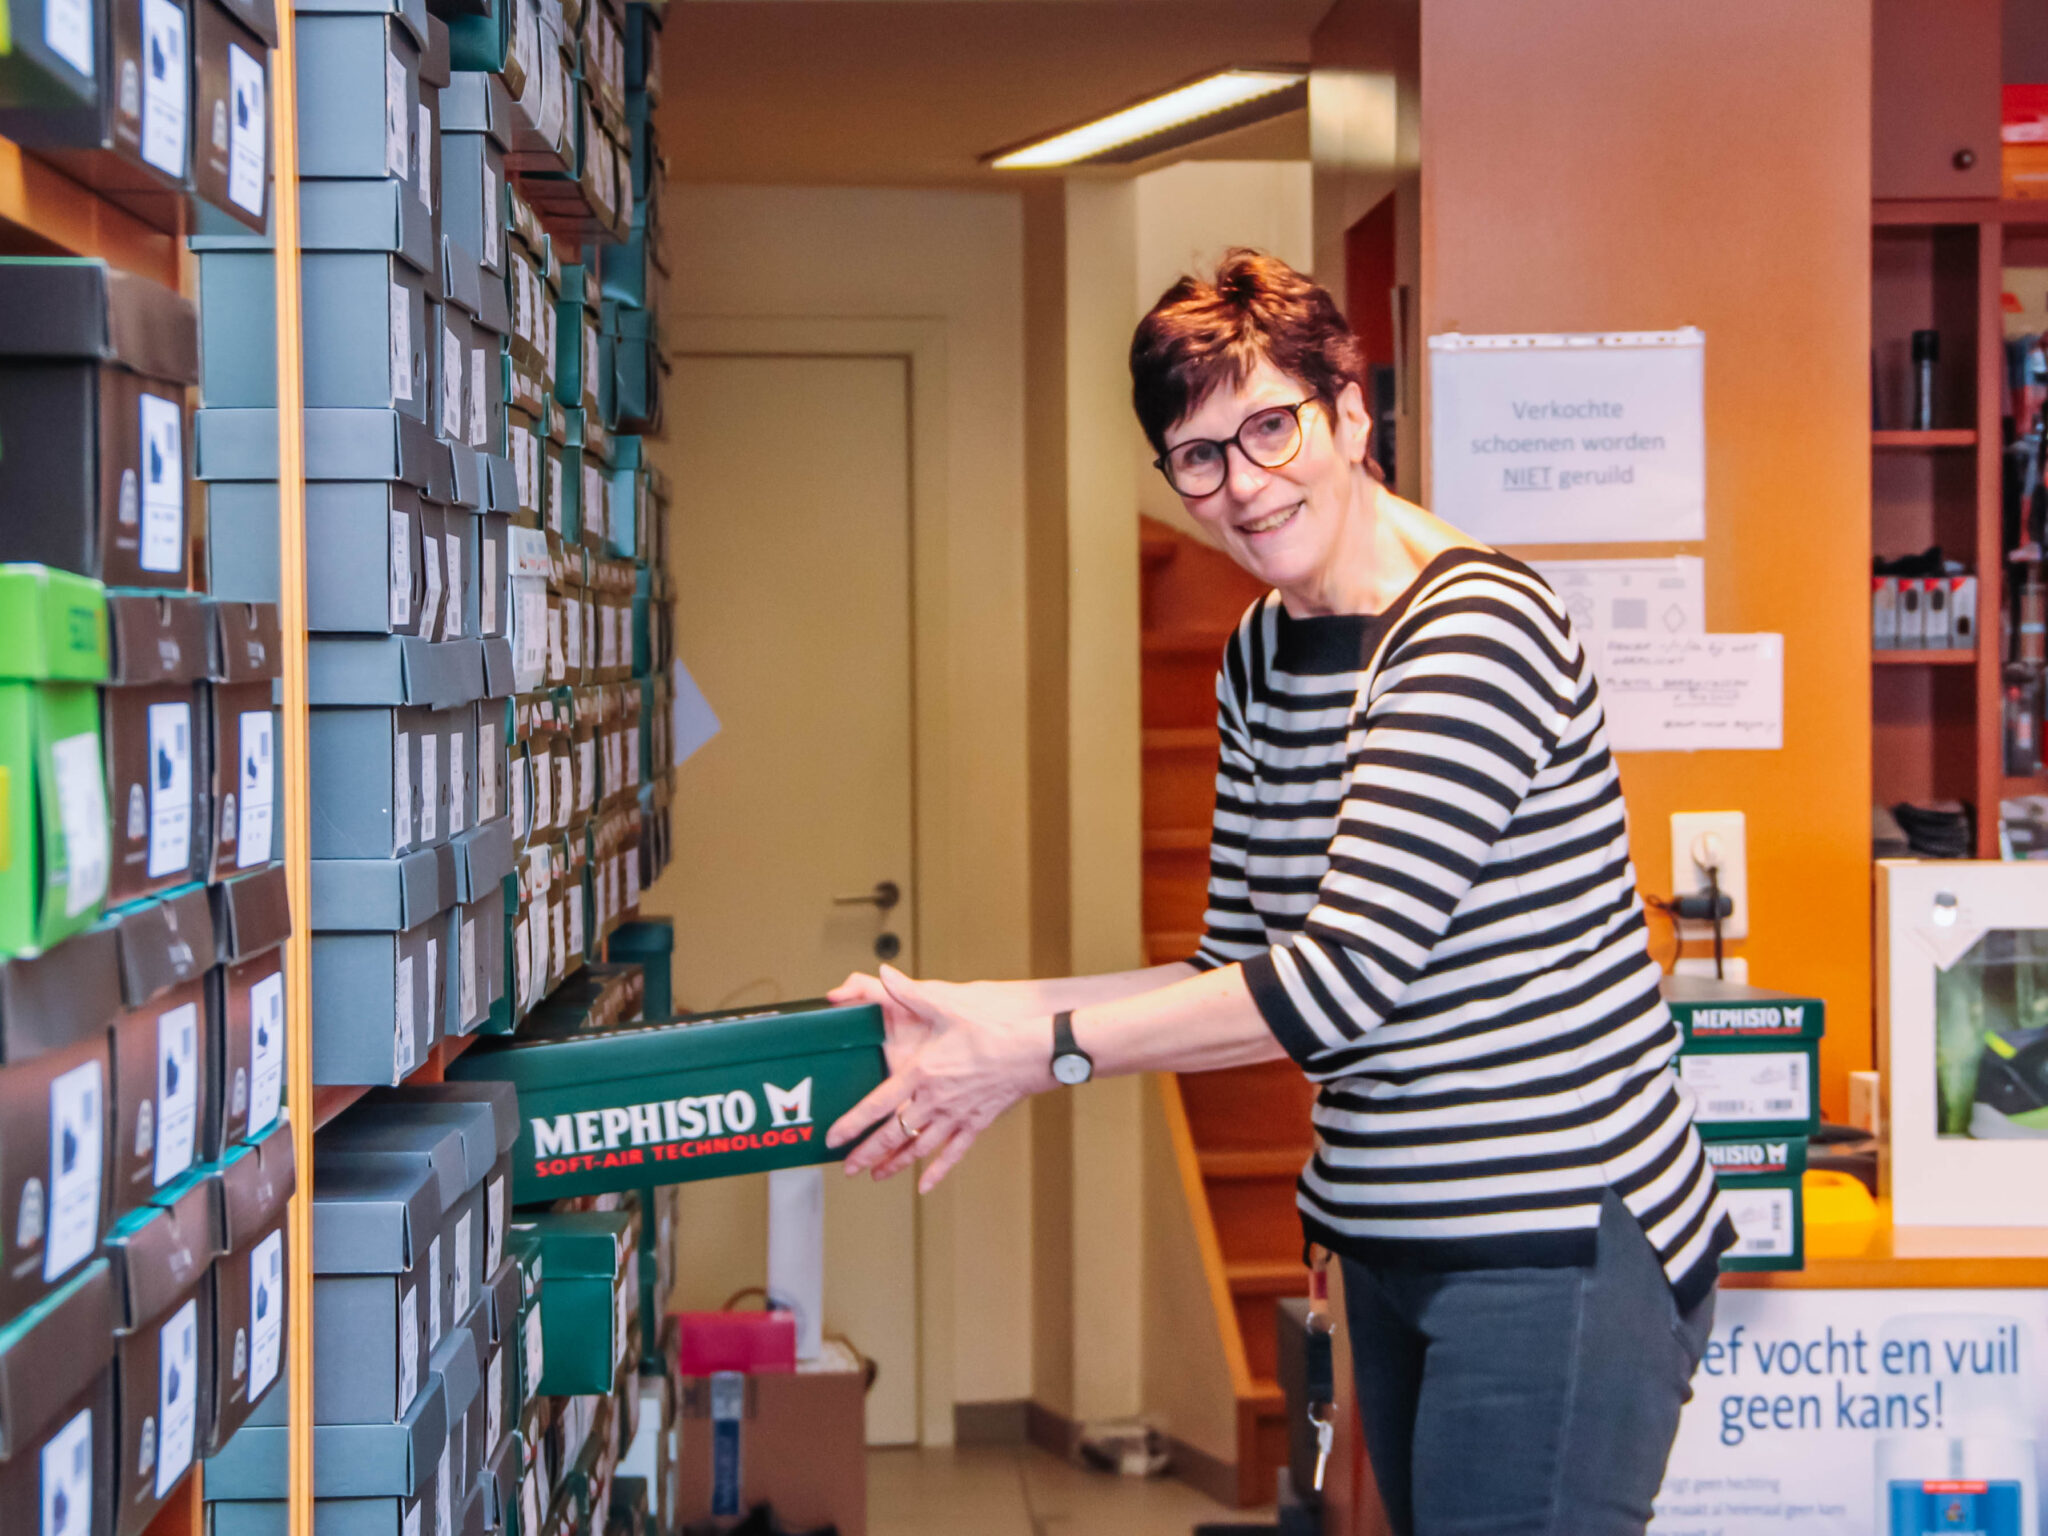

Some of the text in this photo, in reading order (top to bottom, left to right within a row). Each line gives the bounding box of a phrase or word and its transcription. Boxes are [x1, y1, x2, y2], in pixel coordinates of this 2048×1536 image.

[1512, 400, 1624, 421] Verkochte
[1470, 432, 1665, 454] schoenen worden
[1503, 465, 1634, 491] NIET geruild
[1692, 1007, 1782, 1028] MEPHISTO
[530, 1090, 757, 1159] MEPHISTO
[534, 1126, 815, 1178] SOFT-AIR TECHNOLOGY
[1703, 1144, 1765, 1165] PHISTO
[1703, 1325, 2019, 1376] ef vocht en vuil
[1720, 1380, 1944, 1446] geen kans!
